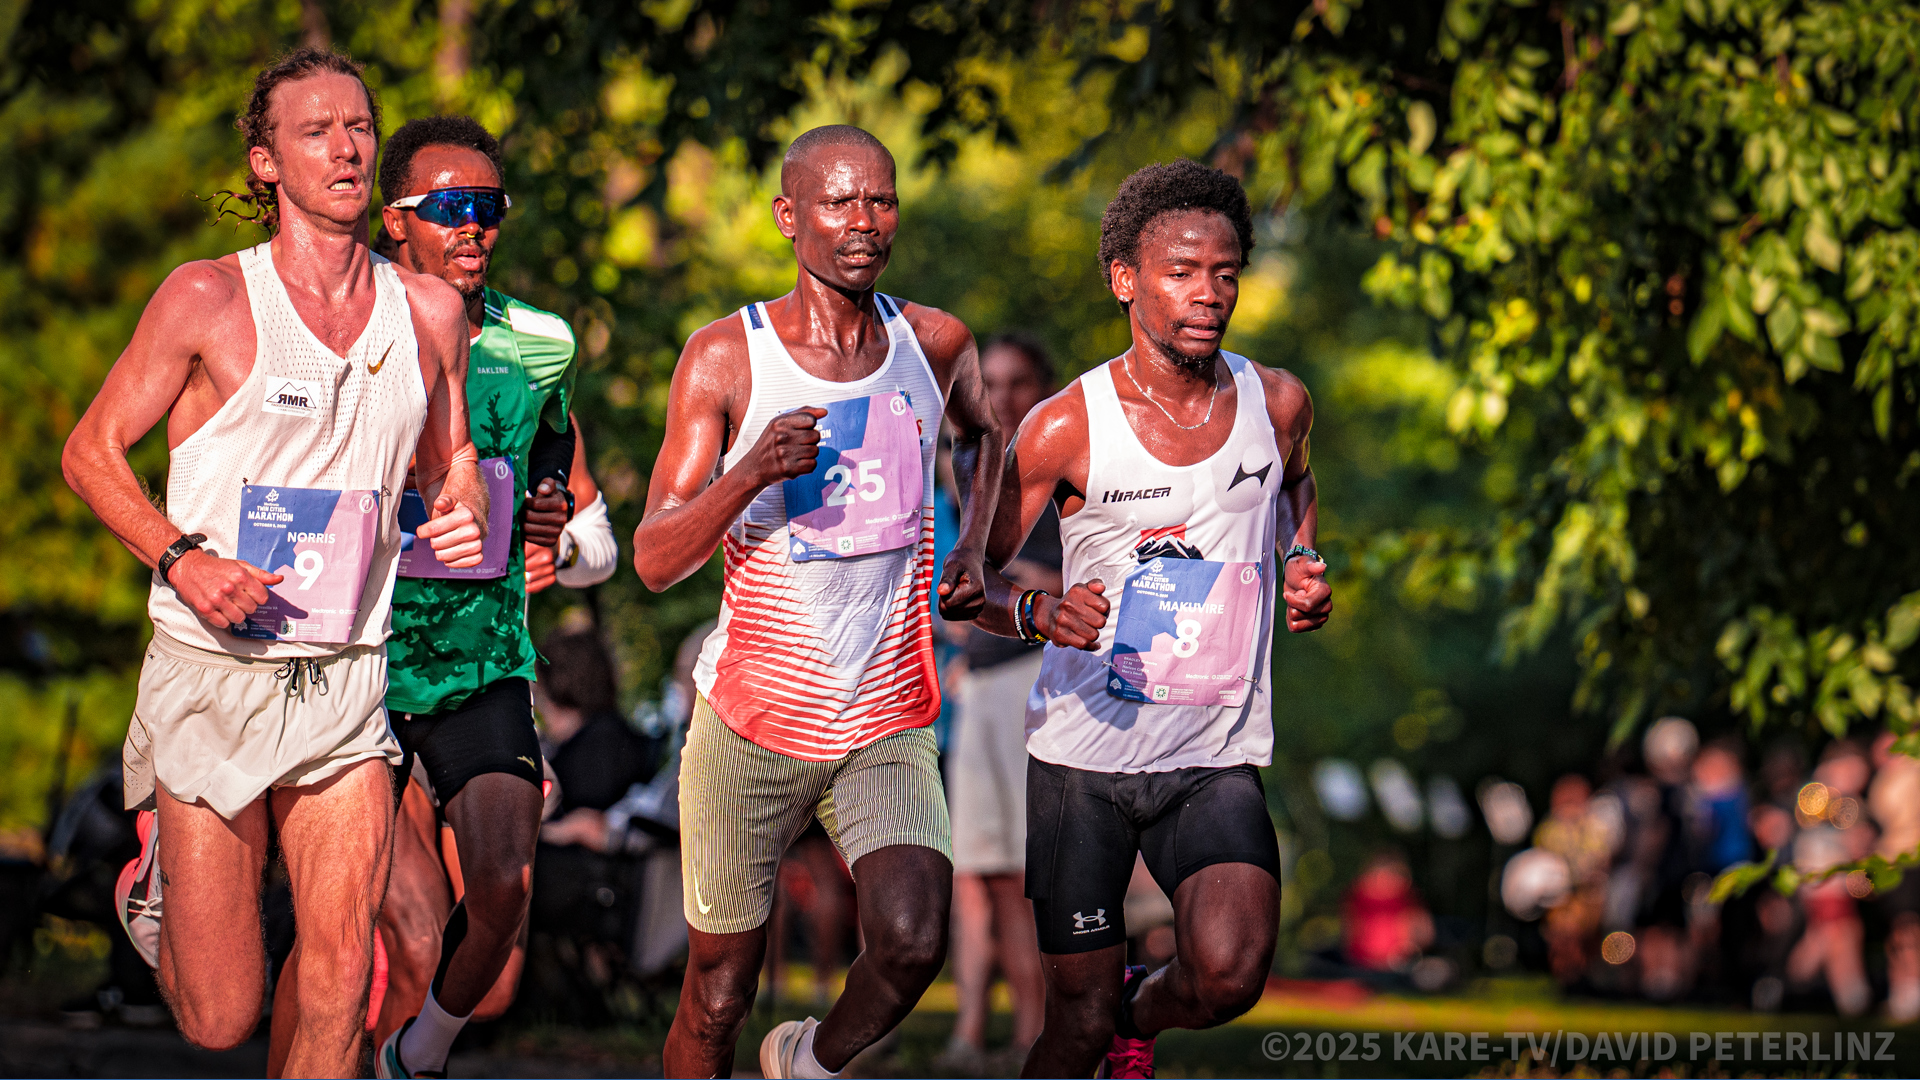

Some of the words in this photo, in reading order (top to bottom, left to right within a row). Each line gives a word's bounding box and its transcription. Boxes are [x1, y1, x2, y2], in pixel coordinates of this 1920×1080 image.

[477, 366, 509, 374] BAKLINE
[824, 458, 886, 507] 25
[1102, 486, 1172, 504] HIRACER
[248, 511, 294, 522] MARATHON
[287, 531, 336, 544] NORRIS
[294, 549, 325, 591] 9
[1131, 579, 1176, 592] MARATHON
[311, 607, 337, 615] Medtronic
[1159, 600, 1225, 615] MAKUVIRE
[1172, 618, 1202, 659] 8
